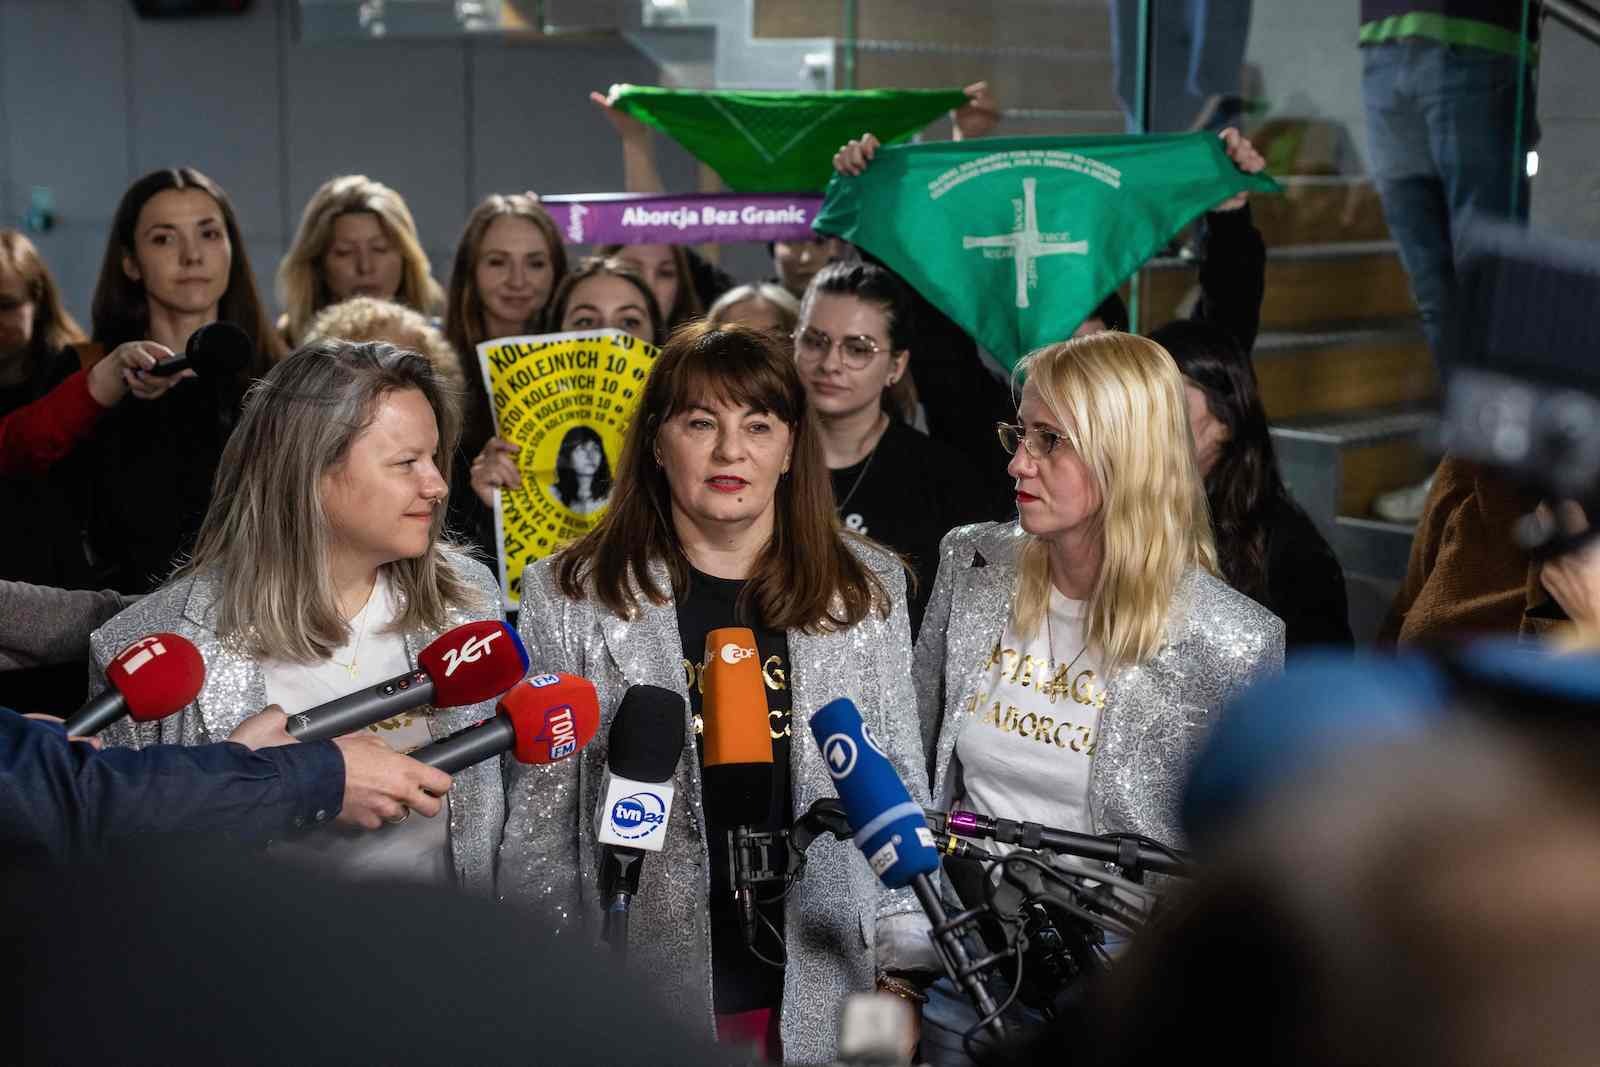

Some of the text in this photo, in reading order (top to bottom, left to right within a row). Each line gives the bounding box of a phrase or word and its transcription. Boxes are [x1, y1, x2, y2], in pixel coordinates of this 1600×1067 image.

[621, 204, 807, 230] Aborcja Bez Granic
[507, 351, 599, 394] KOLEJNYCH
[604, 354, 627, 375] 10
[503, 374, 618, 436] STOI KOLEJNYCH 10
[534, 394, 594, 421] KOLEJNYCH
[596, 396, 612, 410] 10
[441, 630, 502, 678] ZET
[536, 676, 557, 687] FM
[550, 708, 576, 758] TOK FM
